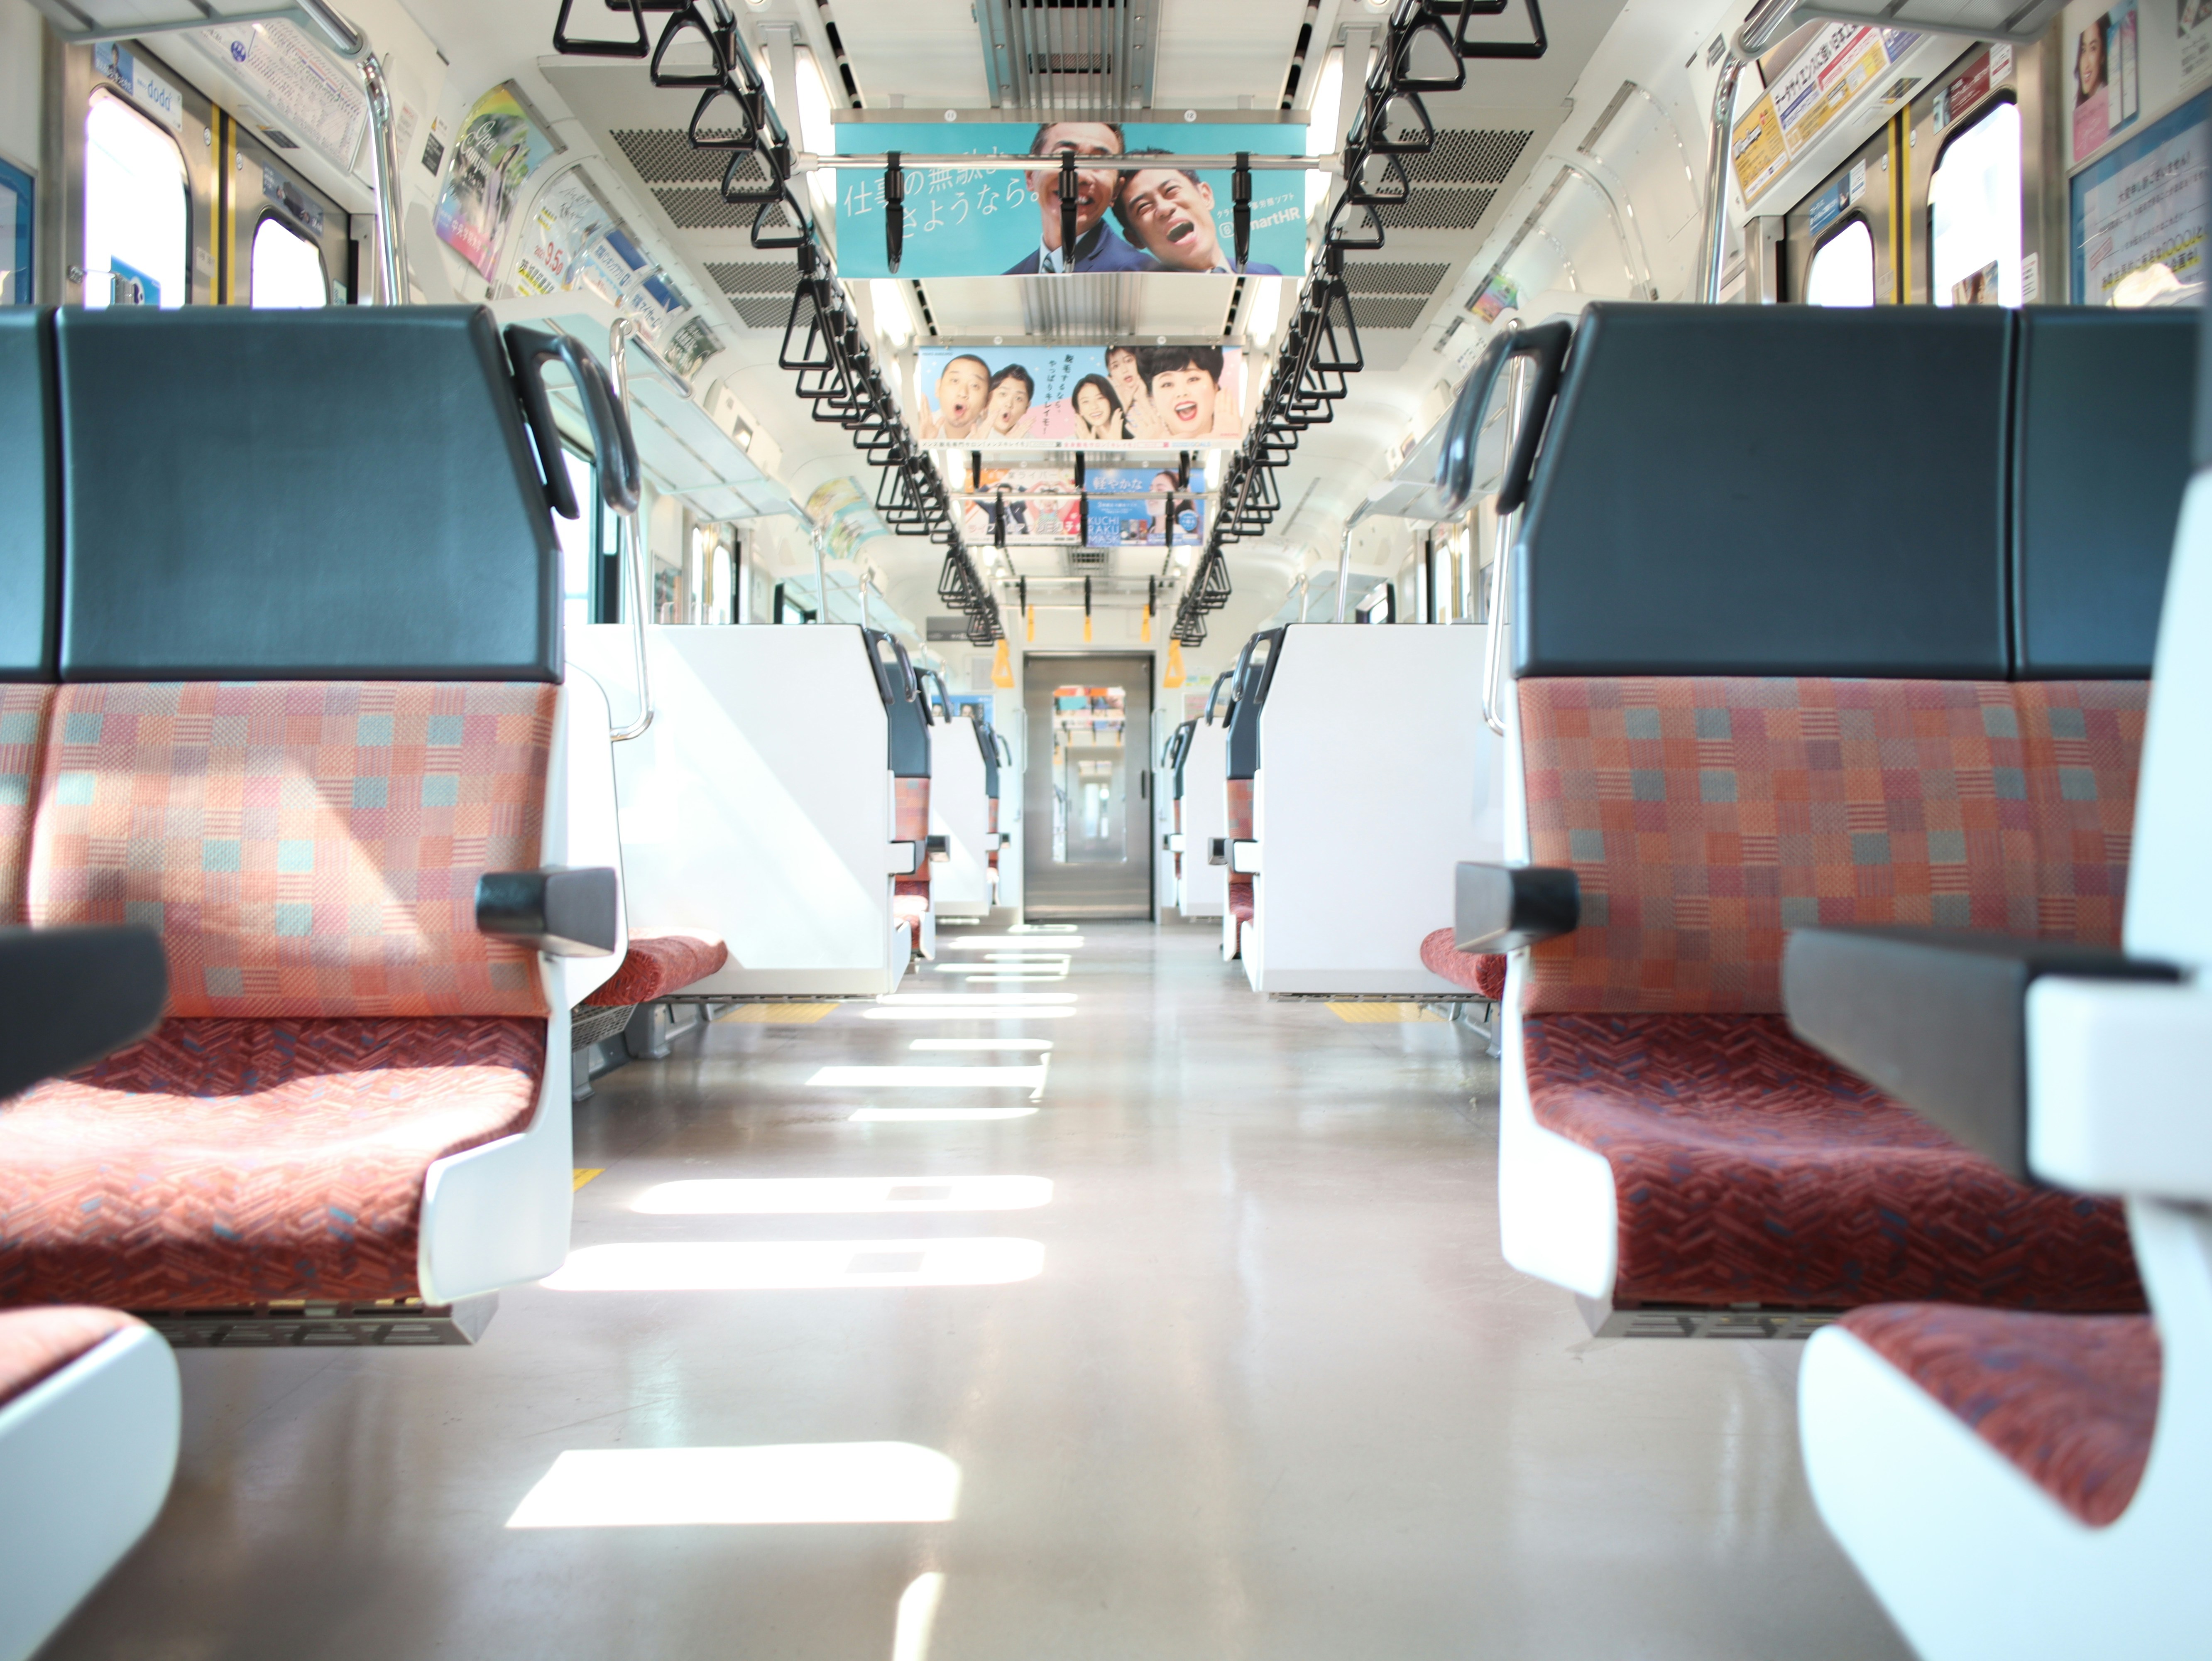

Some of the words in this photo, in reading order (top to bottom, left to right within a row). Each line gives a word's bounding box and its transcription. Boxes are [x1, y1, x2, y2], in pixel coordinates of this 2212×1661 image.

[1250, 206, 1301, 231] martHR
[1093, 476, 1143, 490] 軽やかな
